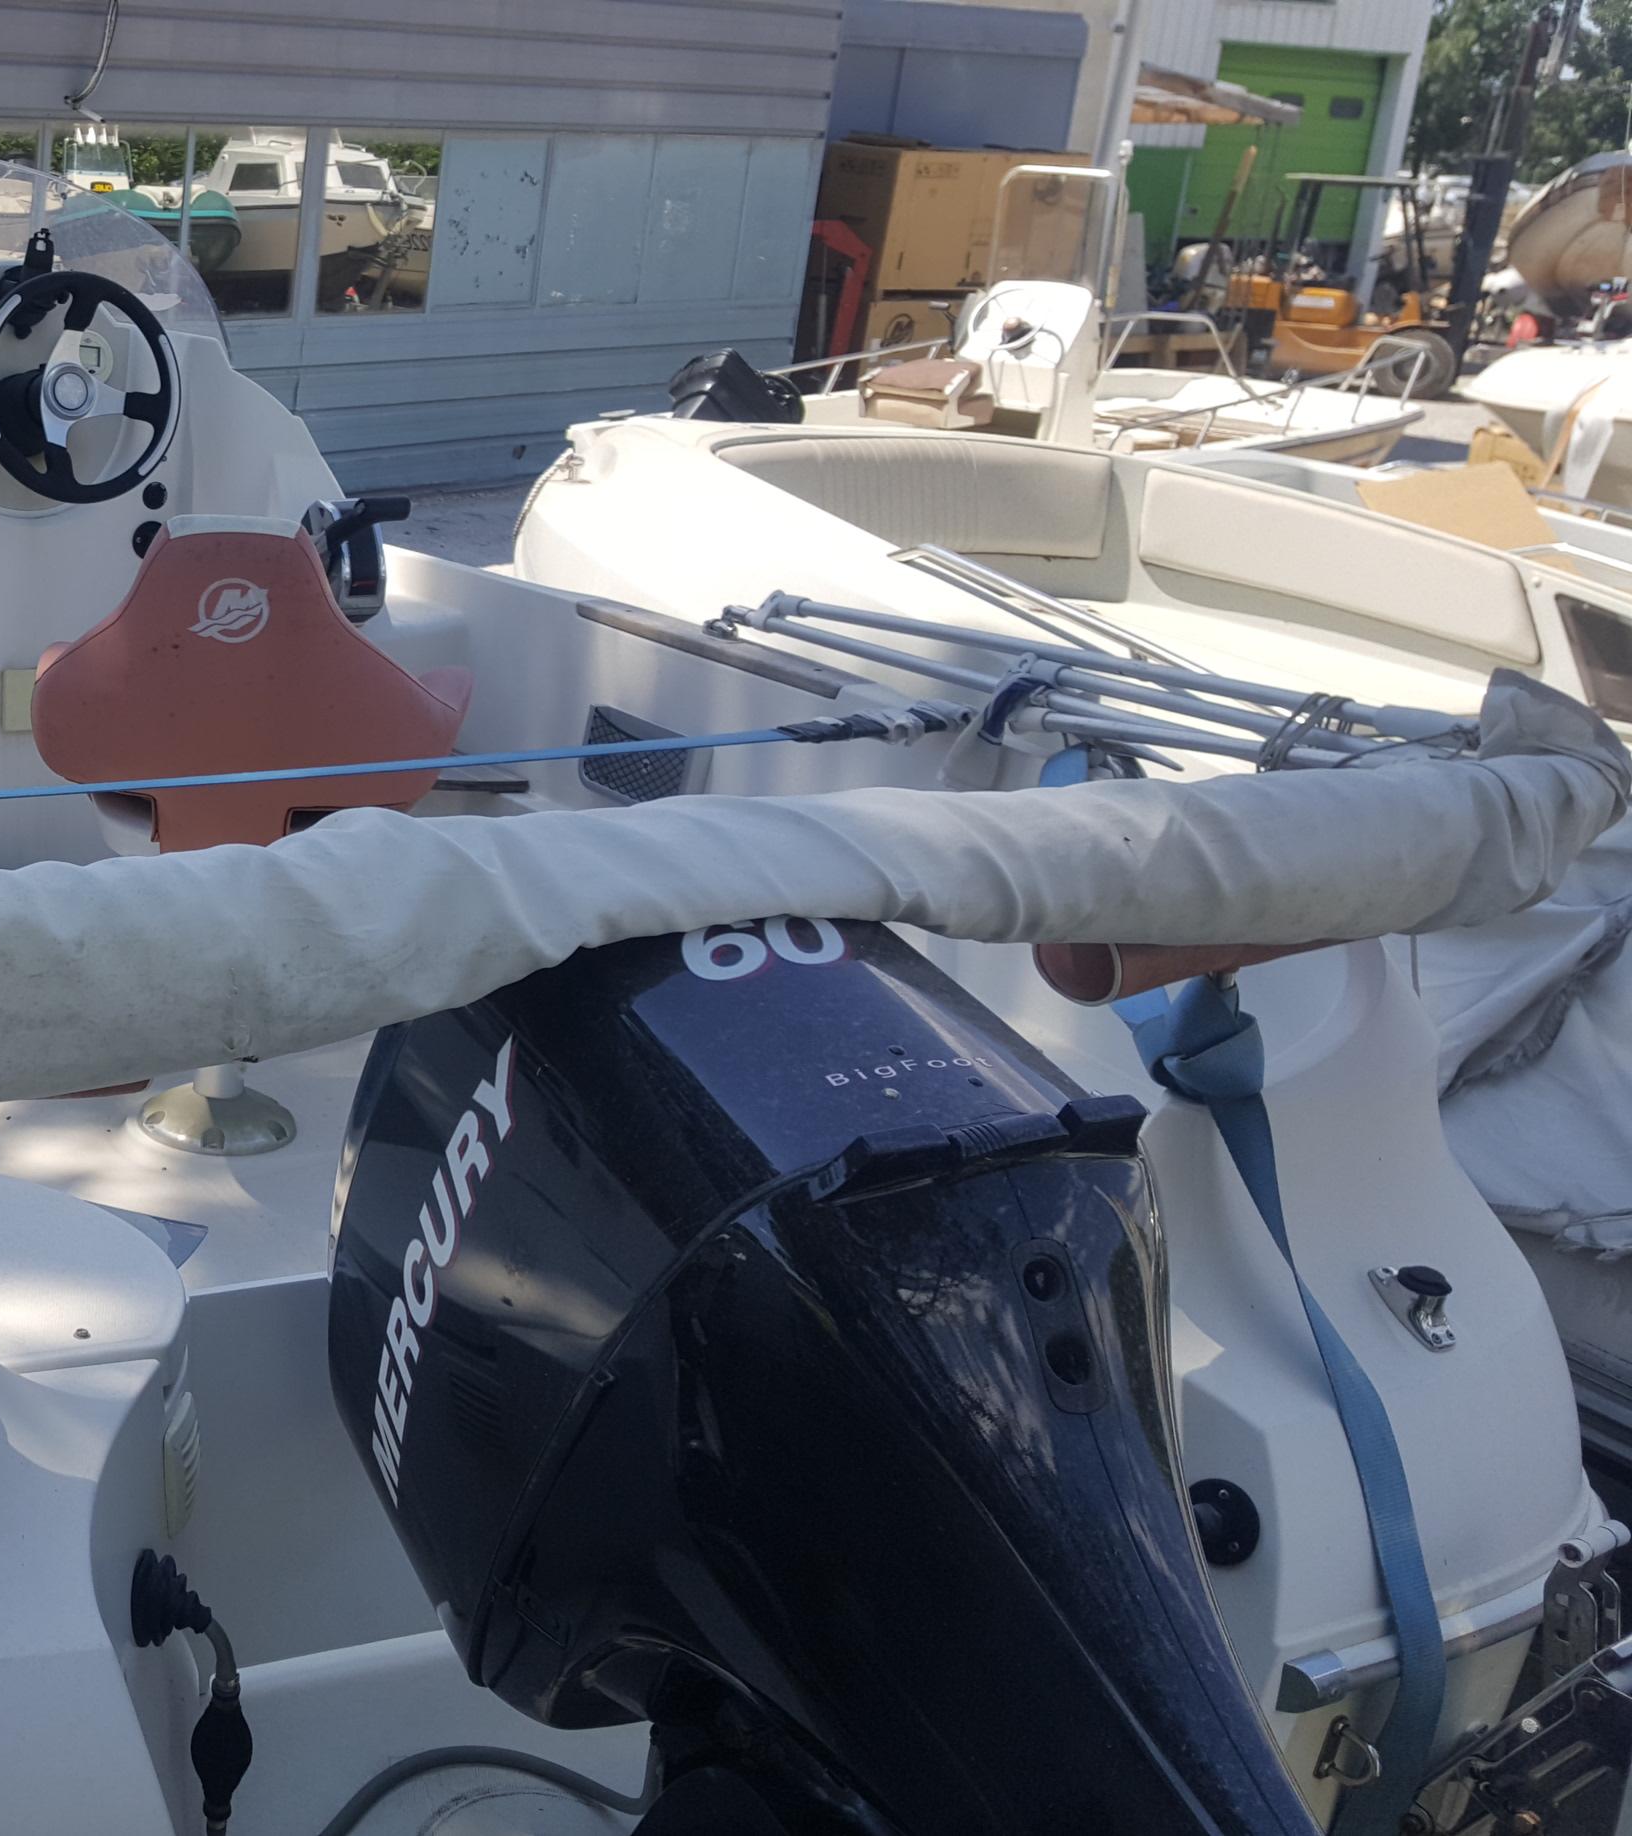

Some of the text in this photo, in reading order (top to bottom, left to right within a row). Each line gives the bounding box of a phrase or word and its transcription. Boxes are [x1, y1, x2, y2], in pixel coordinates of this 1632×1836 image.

[681, 916, 846, 981] 60
[824, 1056, 994, 1088] BigFoot
[371, 1032, 515, 1509] MERCURY
